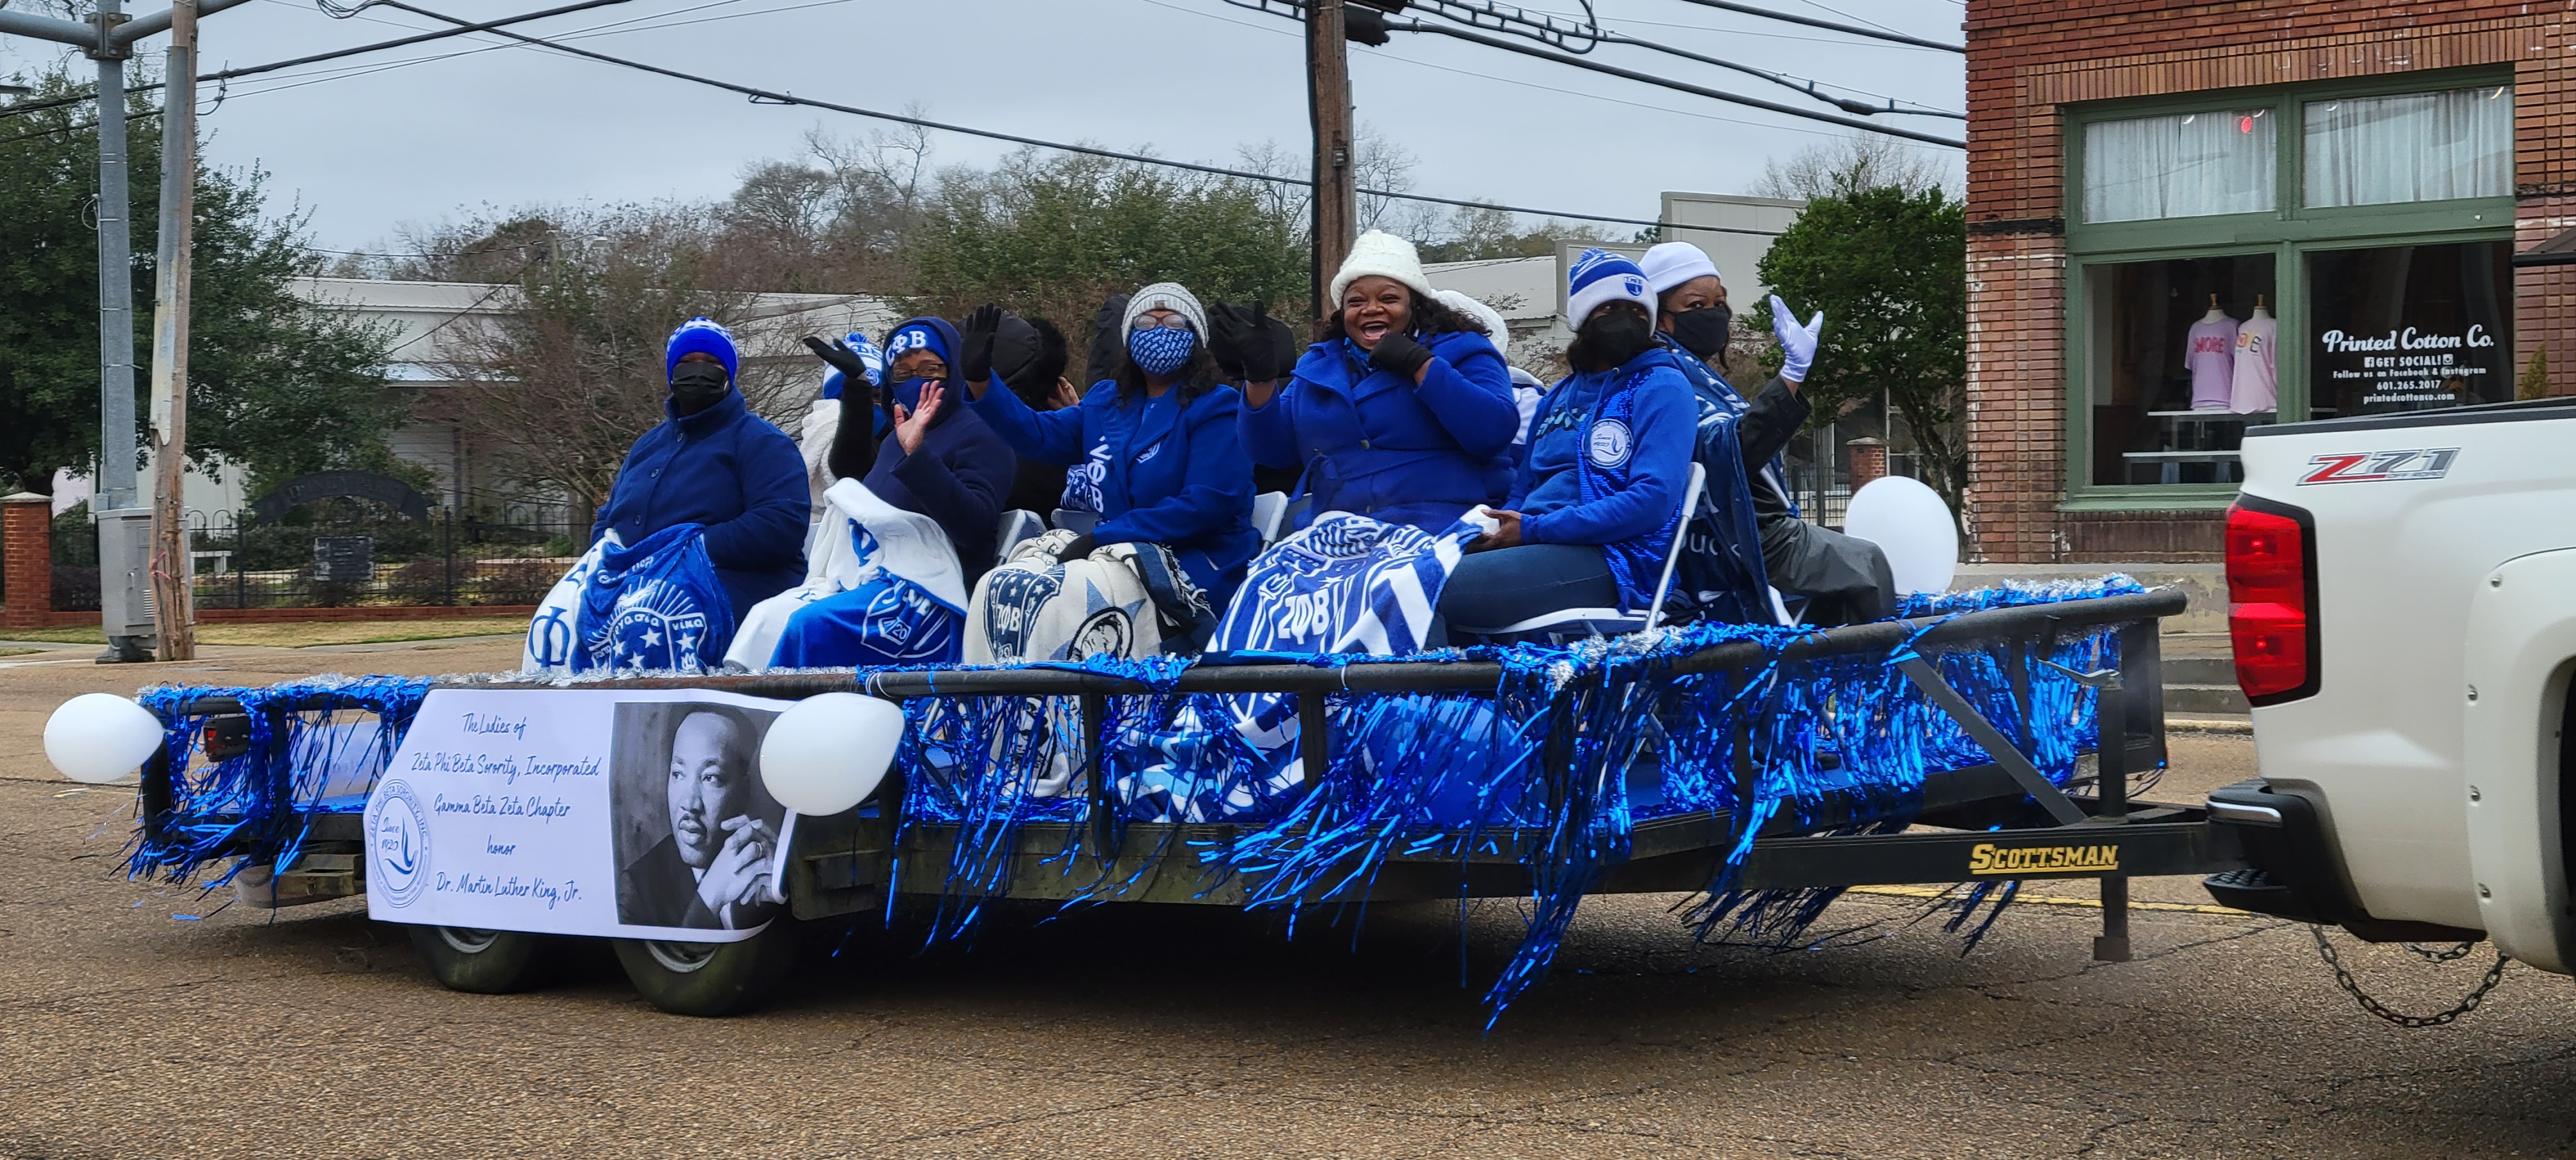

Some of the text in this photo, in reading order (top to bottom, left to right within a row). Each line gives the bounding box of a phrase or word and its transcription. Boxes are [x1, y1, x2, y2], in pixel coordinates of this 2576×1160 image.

[2322, 324, 2494, 353] Printed Cotton Co.
[2333, 370, 2361, 378] Follow
[2389, 368, 2429, 377] Facebook
[2441, 367, 2487, 376] Instagram
[2376, 355, 2441, 367] GET SOCIAL!
[2377, 380, 2441, 390] 601.265.2017
[2363, 393, 2455, 404] printedcottonco.com
[2296, 446, 2462, 486] Z71
[463, 713, 526, 740] The Ladies of
[411, 752, 602, 785] Zeta Phi Beta Sorority, Incorporated
[434, 793, 571, 825] Gamma Beta Zeta Chapter
[381, 816, 400, 834] Since
[381, 839, 399, 853] 1920
[487, 834, 516, 855] honor
[1968, 843, 2119, 871] SCOTTSMAN
[436, 871, 453, 892] Dr.
[456, 873, 493, 894] Martin
[494, 876, 530, 897] Luther
[531, 878, 561, 910] King,
[564, 880, 582, 901] Jr.
